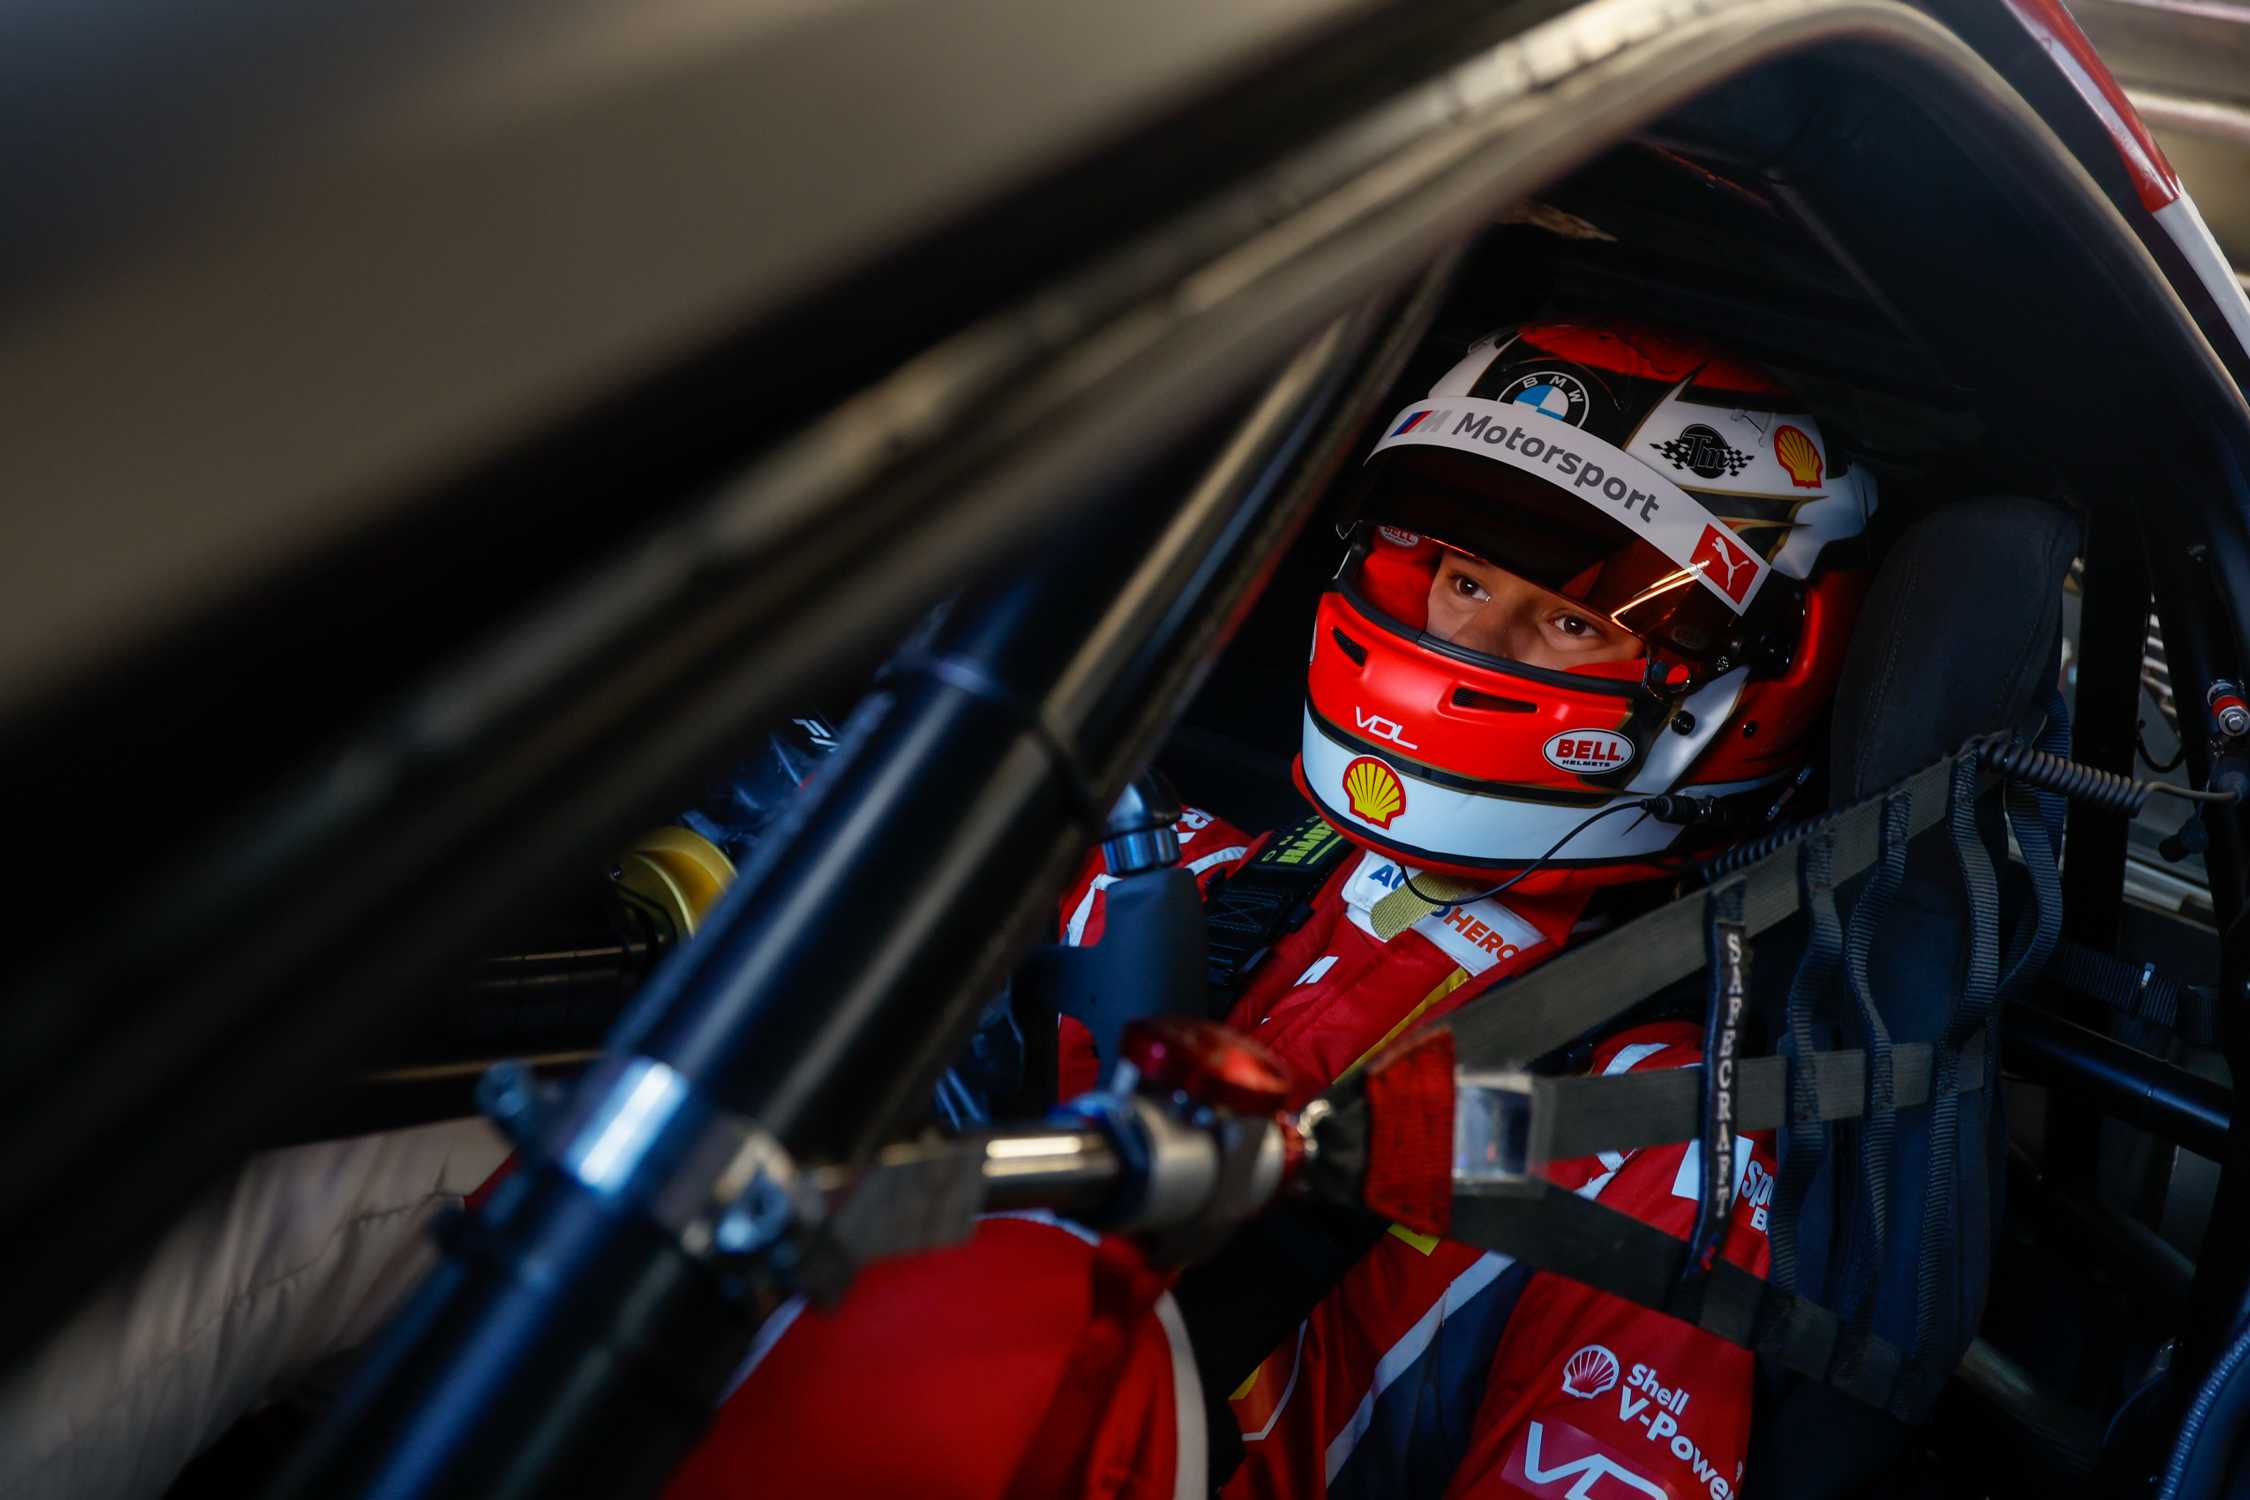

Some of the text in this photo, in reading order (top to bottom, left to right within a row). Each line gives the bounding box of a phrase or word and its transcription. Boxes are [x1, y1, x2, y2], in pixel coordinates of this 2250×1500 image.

[1523, 375, 1583, 403] BMW
[1451, 412, 1660, 523] Motorsport
[1355, 705, 1418, 750] VDL
[1556, 739, 1622, 761] BELL
[1716, 932, 1743, 1218] SAFECRAFT
[1626, 1363, 1690, 1416] Shell
